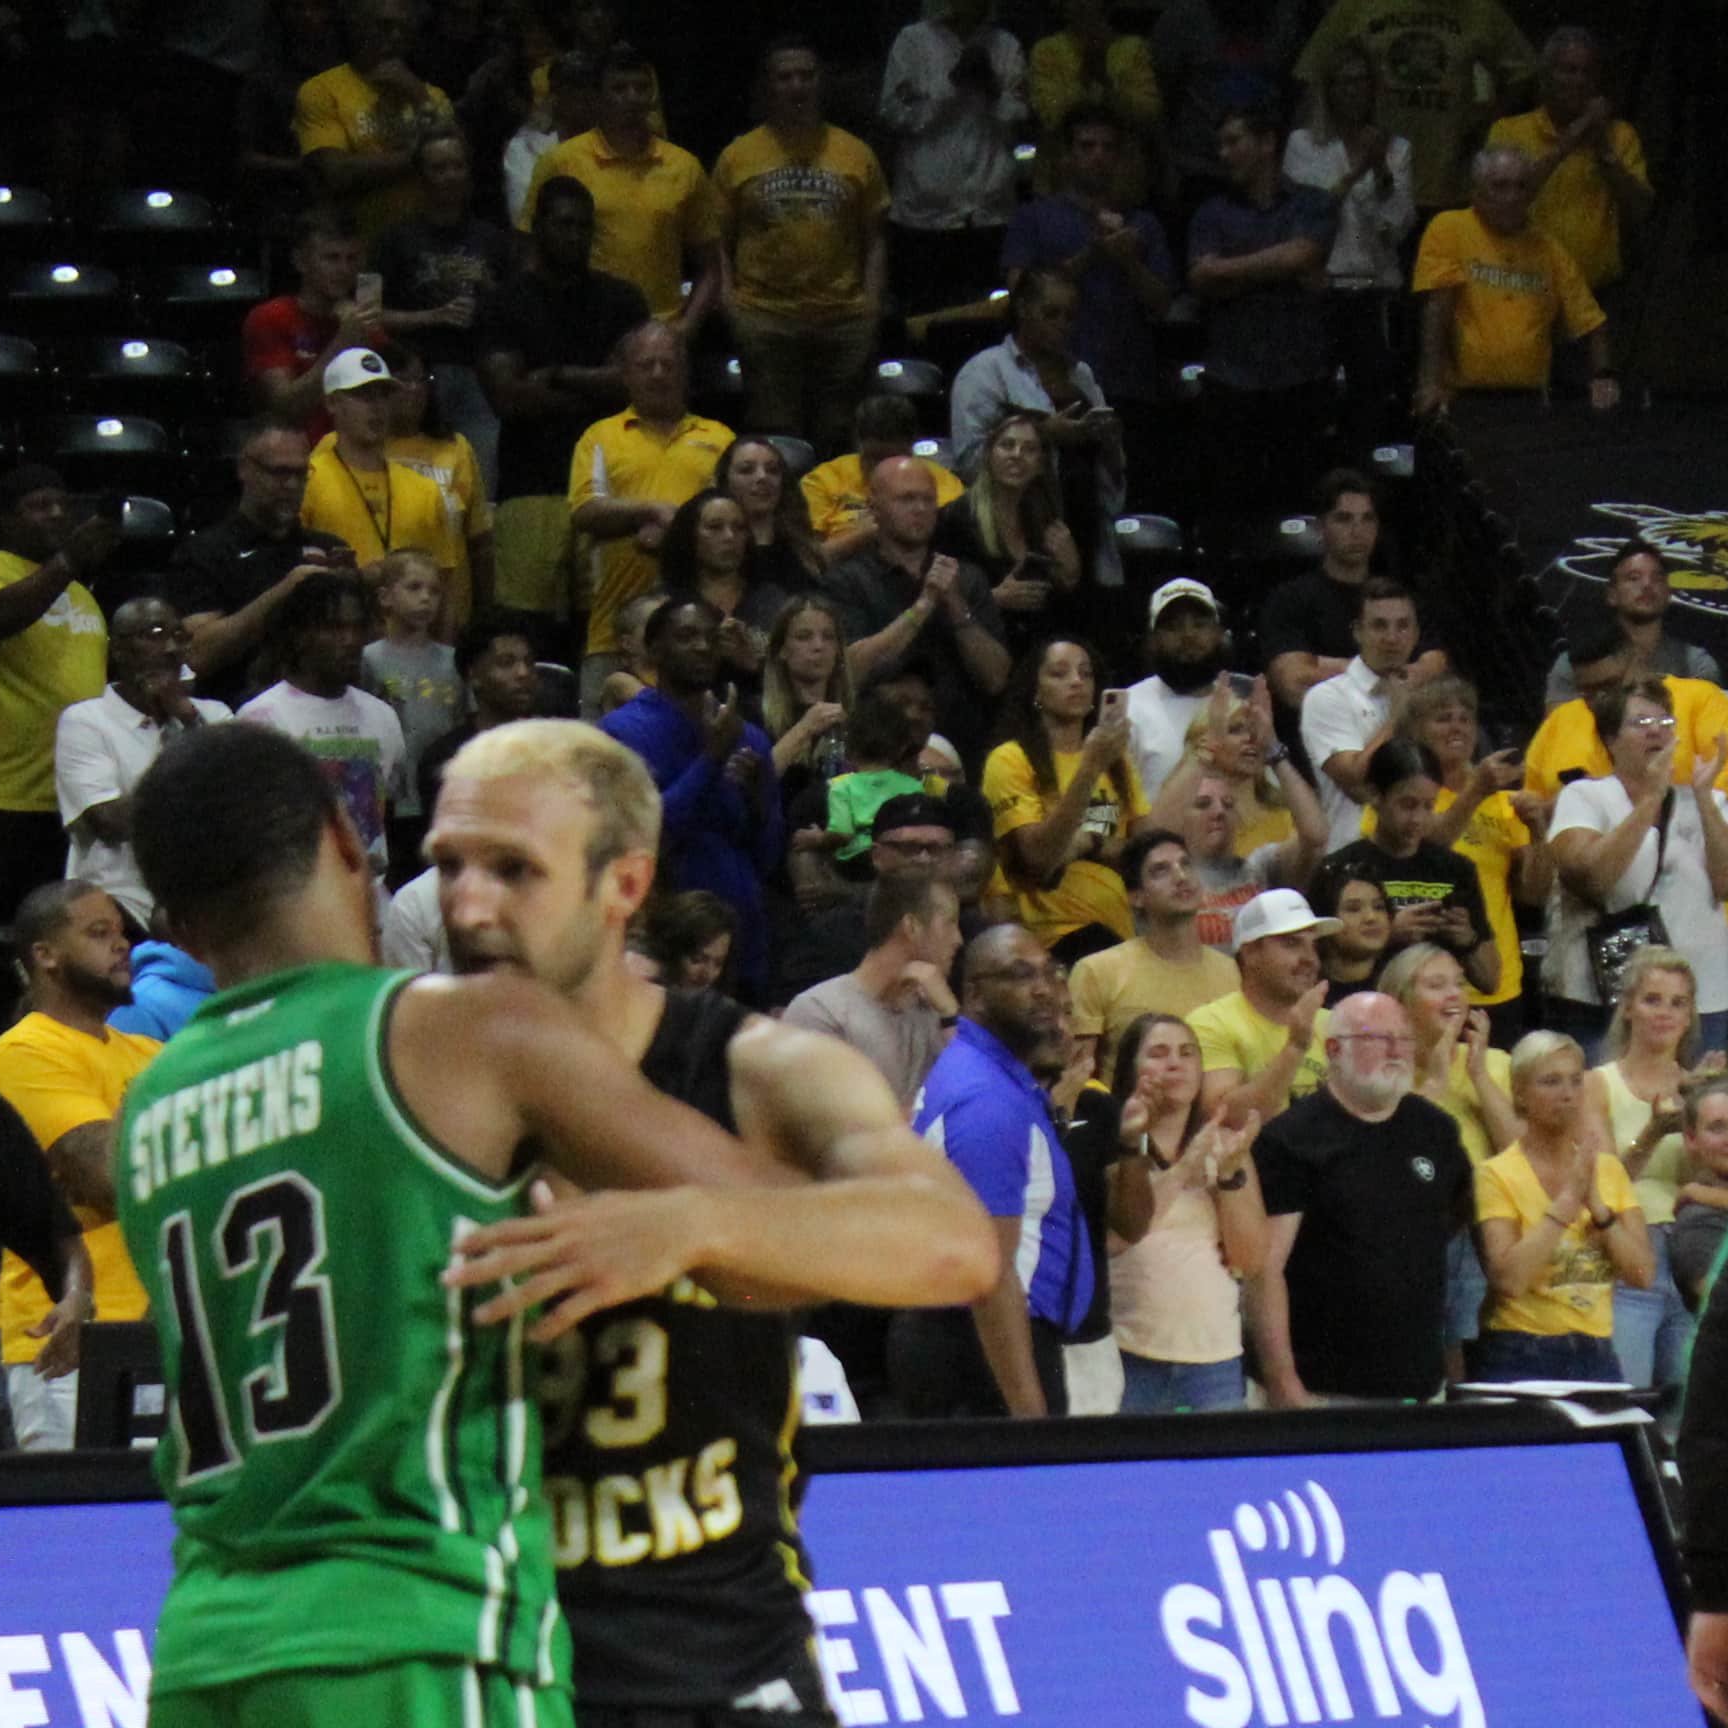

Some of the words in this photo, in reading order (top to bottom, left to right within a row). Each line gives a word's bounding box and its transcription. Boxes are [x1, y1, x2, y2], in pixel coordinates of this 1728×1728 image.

[130, 1040, 323, 1203] STEVENS
[159, 1168, 345, 1489] 13
[542, 1436, 744, 1570] OCKS
